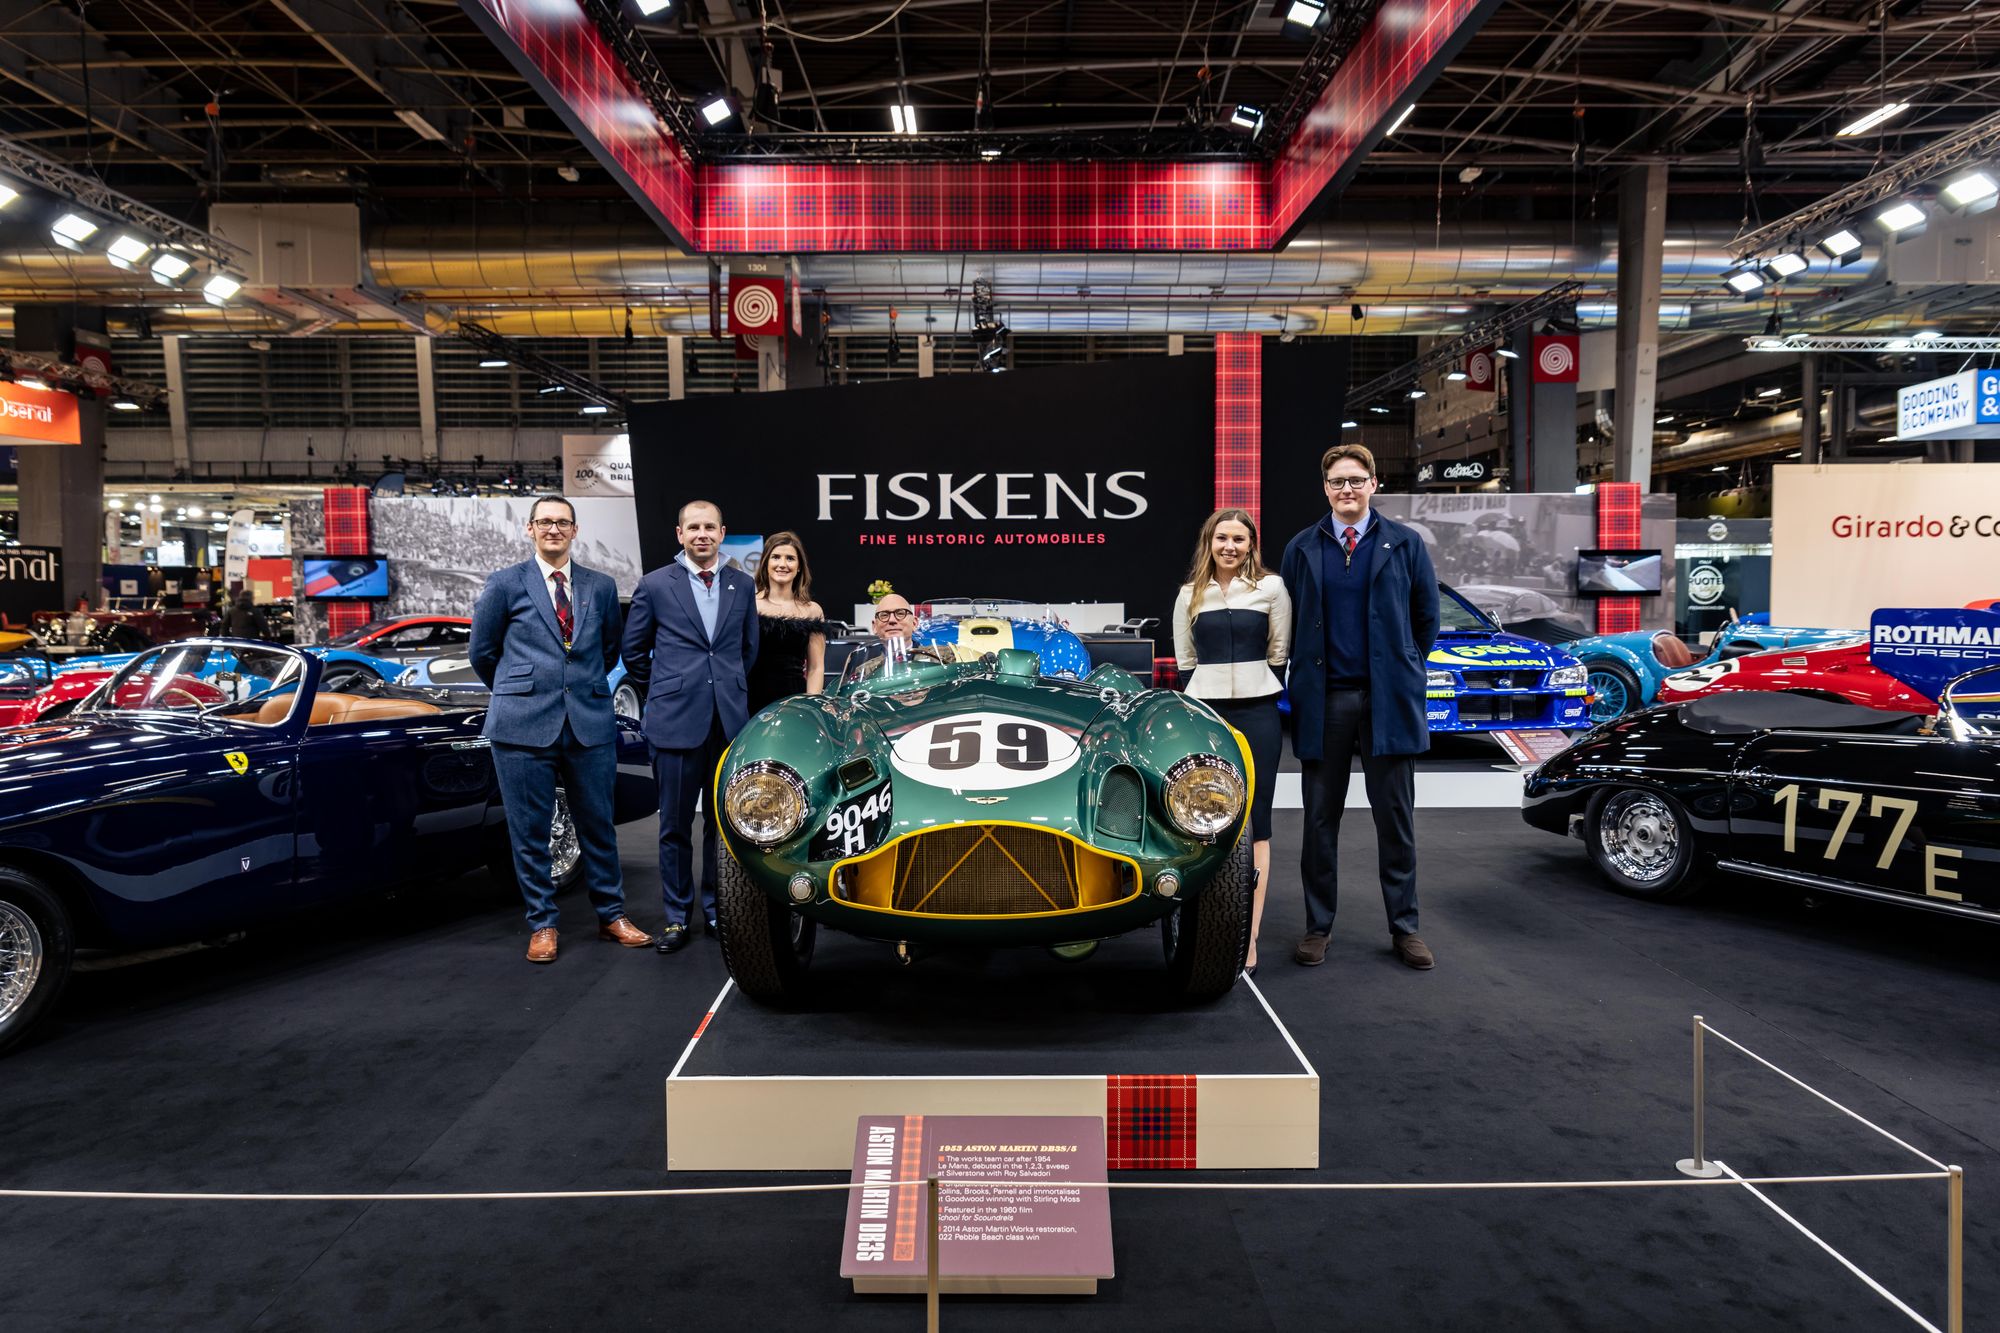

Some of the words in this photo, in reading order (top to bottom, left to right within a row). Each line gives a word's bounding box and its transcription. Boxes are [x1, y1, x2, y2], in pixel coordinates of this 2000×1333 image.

[1904, 383, 1958, 411] GOODING
[576, 469, 594, 478] 100
[817, 471, 1148, 521] FISKENS
[1418, 493, 1438, 515] 24
[860, 534, 897, 545] FINE
[907, 534, 985, 545] HISTORIC
[994, 533, 1106, 545] AUTOMOBILES
[1832, 515, 1944, 538] Girardo
[1950, 515, 1970, 538] &
[928, 720, 1049, 771] 59
[826, 781, 892, 842] 9046
[844, 825, 866, 856] H
[1773, 784, 1919, 870] 177
[1925, 844, 1963, 902] E
[866, 1126, 896, 1165] ASTON
[860, 1169, 892, 1219] MARTIN
[945, 1195, 984, 1203] Goodwood
[986, 1195, 1014, 1203] winning
[1015, 1195, 1032, 1203] with
[1033, 1195, 1058, 1203] Stirling
[1060, 1195, 1080, 1203] Moss
[943, 1225, 960, 1233] 2014
[961, 1225, 983, 1233] Aston
[985, 1225, 1009, 1233] Martin
[1010, 1225, 1034, 1233] Works
[973, 1213, 1014, 1221] Scoundrels
[856, 1223, 887, 1261] DB3S
[954, 1233, 980, 1241] Pebble
[981, 1233, 1004, 1241] Beach
[1005, 1233, 1024, 1241] class
[1025, 1233, 1040, 1241] win
